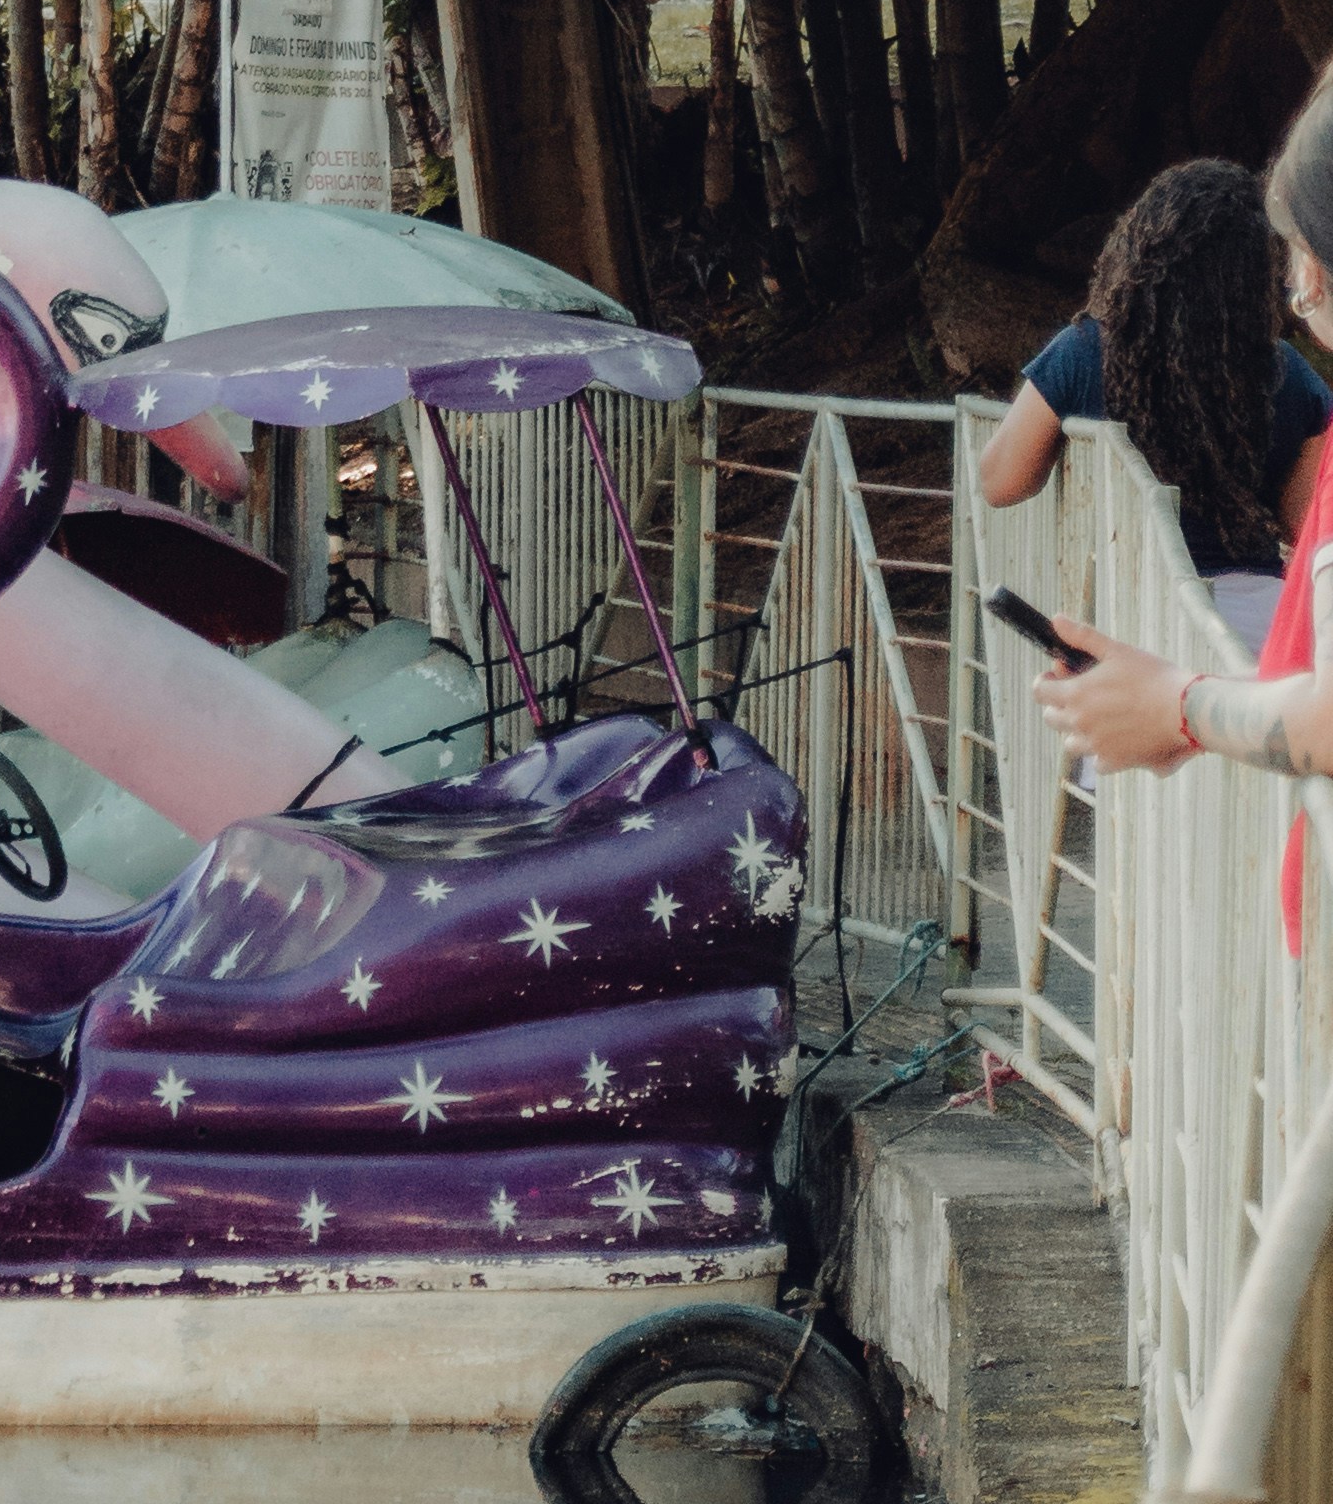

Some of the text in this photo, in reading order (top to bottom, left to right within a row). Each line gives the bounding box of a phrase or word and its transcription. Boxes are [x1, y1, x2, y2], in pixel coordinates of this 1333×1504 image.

[250, 35, 287, 57] DOMINGO
[289, 38, 295, 57] E
[309, 150, 381, 169] COLETE USO
[305, 172, 384, 192] OBRIGATÓRIO
